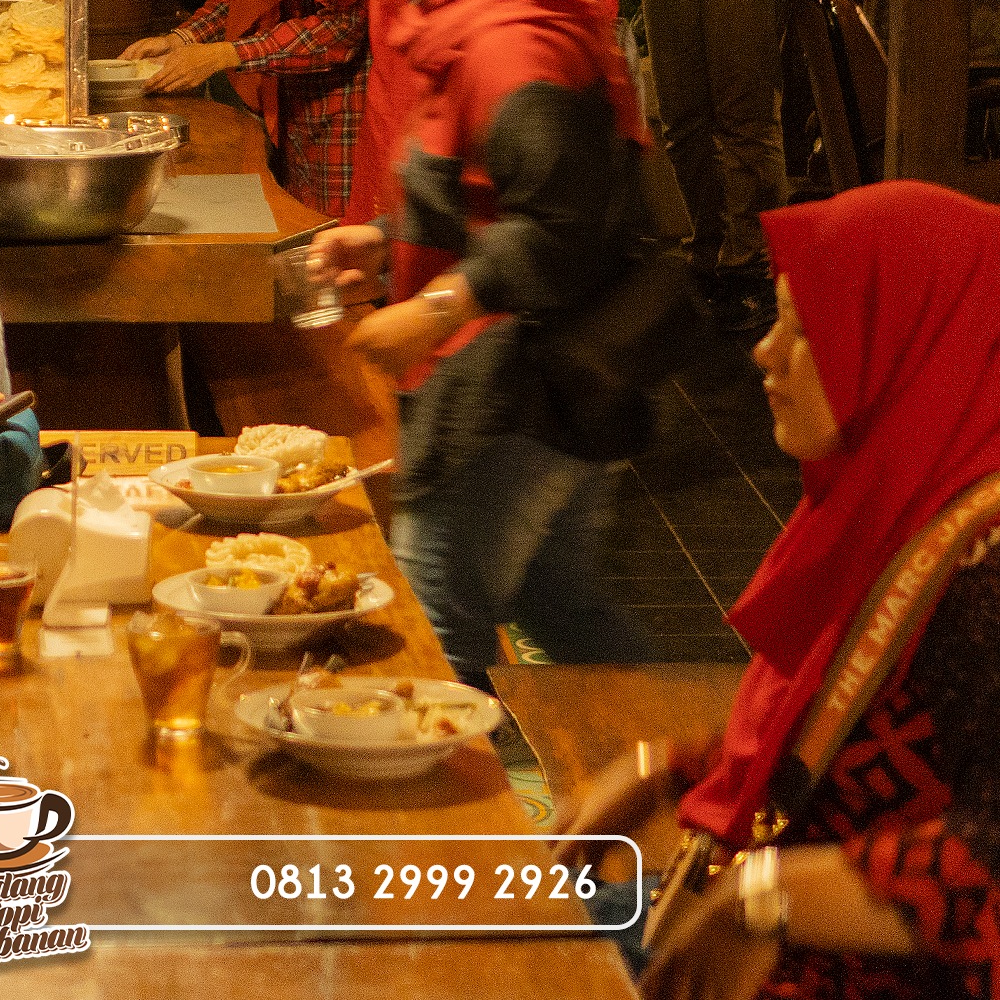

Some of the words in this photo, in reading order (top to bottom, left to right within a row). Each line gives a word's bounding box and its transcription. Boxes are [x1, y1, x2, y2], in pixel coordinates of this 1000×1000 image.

[80, 442, 187, 464] ERVED
[824, 651, 876, 710] THE
[865, 547, 936, 645] MARC
